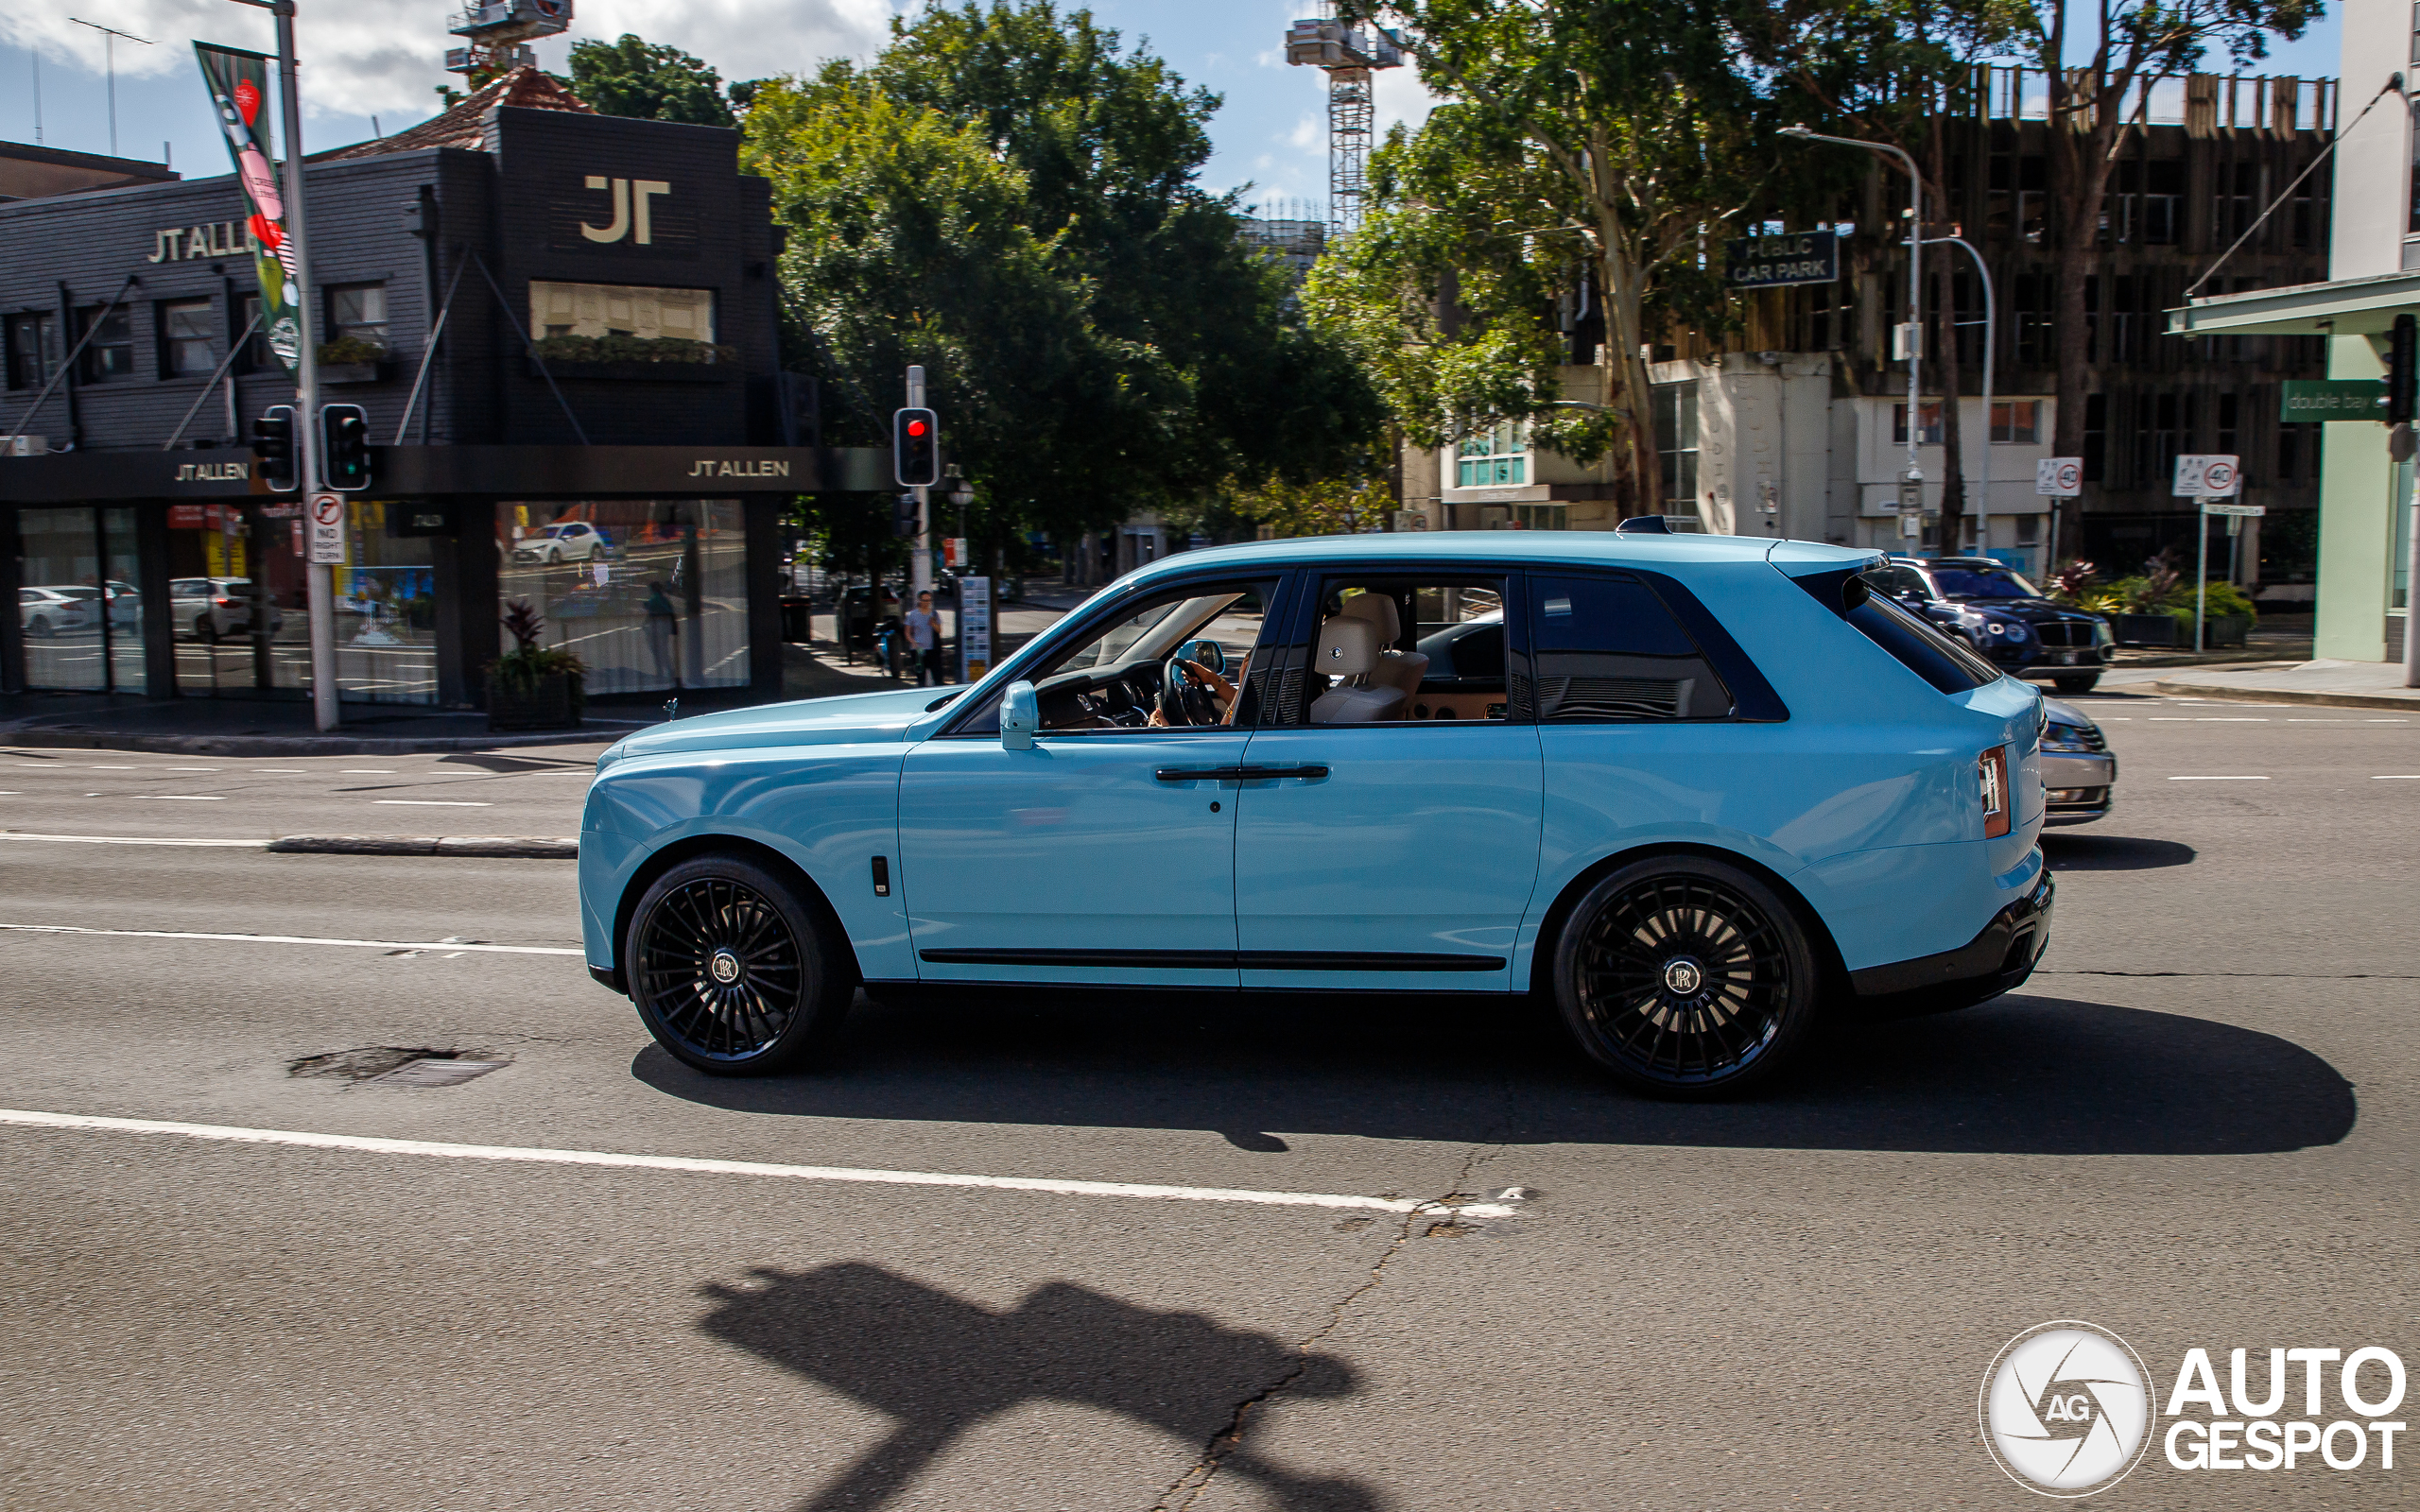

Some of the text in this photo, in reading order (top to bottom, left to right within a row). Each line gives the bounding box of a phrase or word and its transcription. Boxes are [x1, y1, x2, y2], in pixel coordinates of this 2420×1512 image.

[580, 176, 670, 245] JT
[147, 221, 256, 263] JT ALLE
[1734, 260, 1826, 282] CAR PARK
[2288, 392, 2340, 409] double
[2343, 392, 2371, 413] bay
[175, 463, 249, 481] JT ALLEN
[687, 460, 789, 476] JT ALLEN
[317, 528, 338, 539] NO
